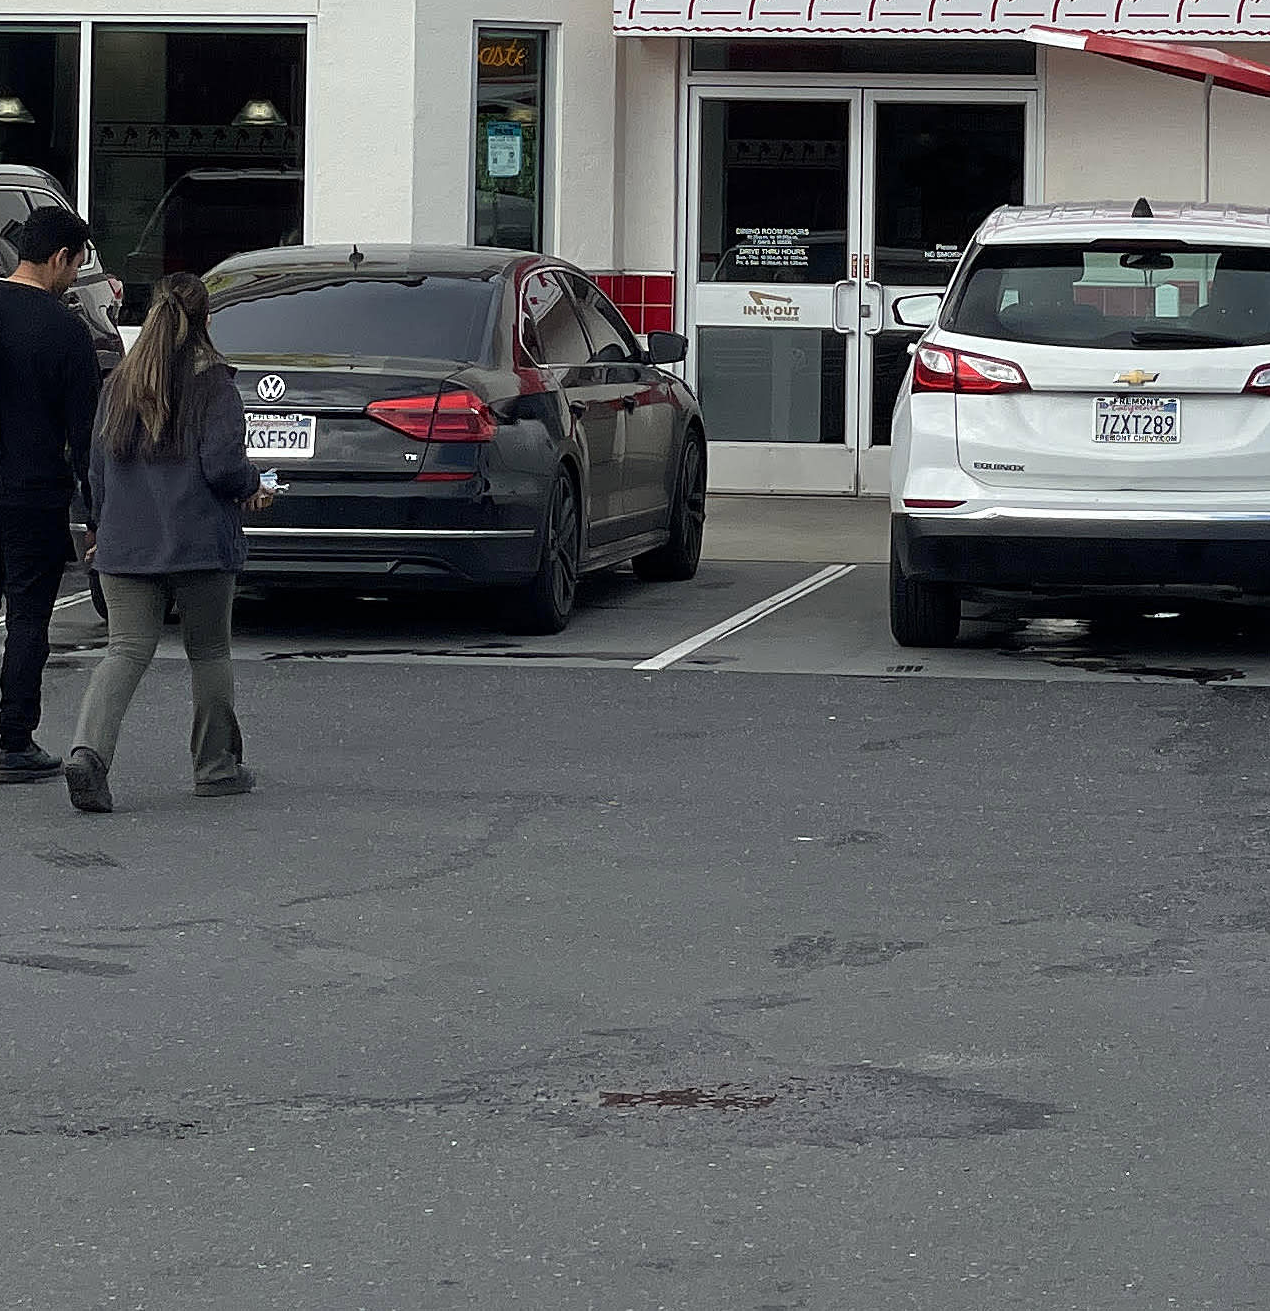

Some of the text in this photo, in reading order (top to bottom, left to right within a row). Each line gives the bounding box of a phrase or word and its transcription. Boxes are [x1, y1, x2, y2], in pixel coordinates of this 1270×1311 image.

[743, 305, 800, 316] IN-N-OUT
[1114, 397, 1159, 406] FREMONT
[1099, 414, 1174, 435] 7ZXT289
[247, 430, 309, 449] KSF590
